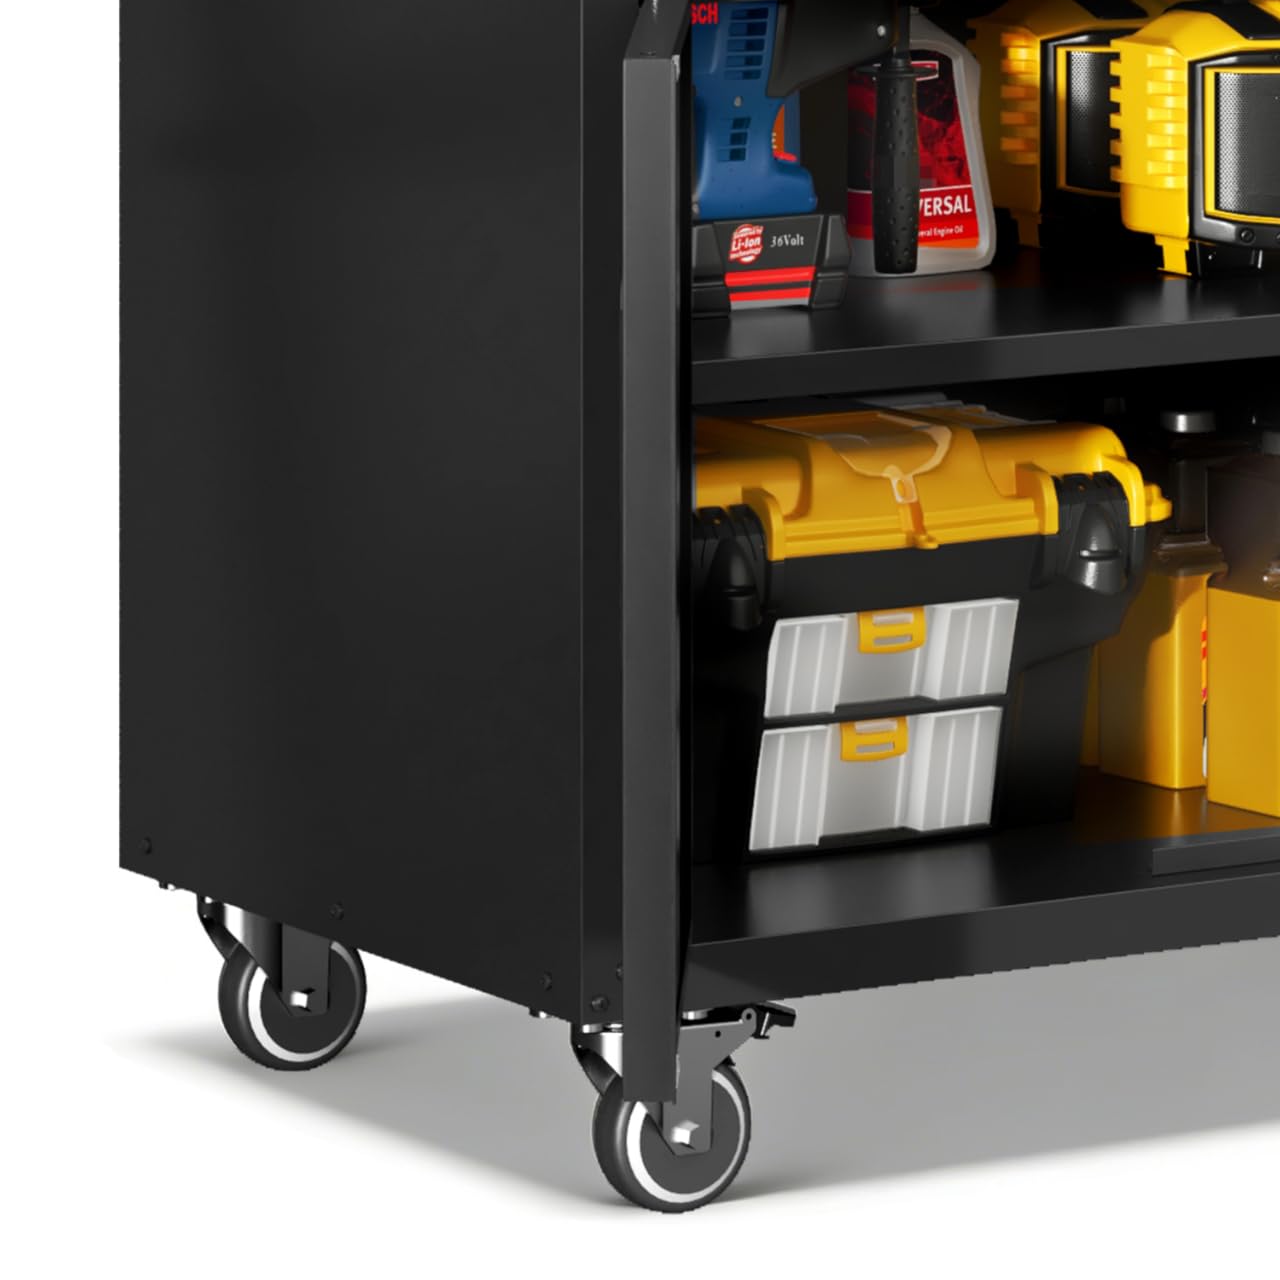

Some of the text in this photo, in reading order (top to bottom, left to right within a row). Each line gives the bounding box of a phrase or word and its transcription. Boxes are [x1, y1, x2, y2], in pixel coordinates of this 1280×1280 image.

[934, 226, 954, 237] Engine
[954, 225, 964, 234] Oil
[731, 237, 761, 251] Li-Ion
[770, 233, 804, 248] 36Volt
